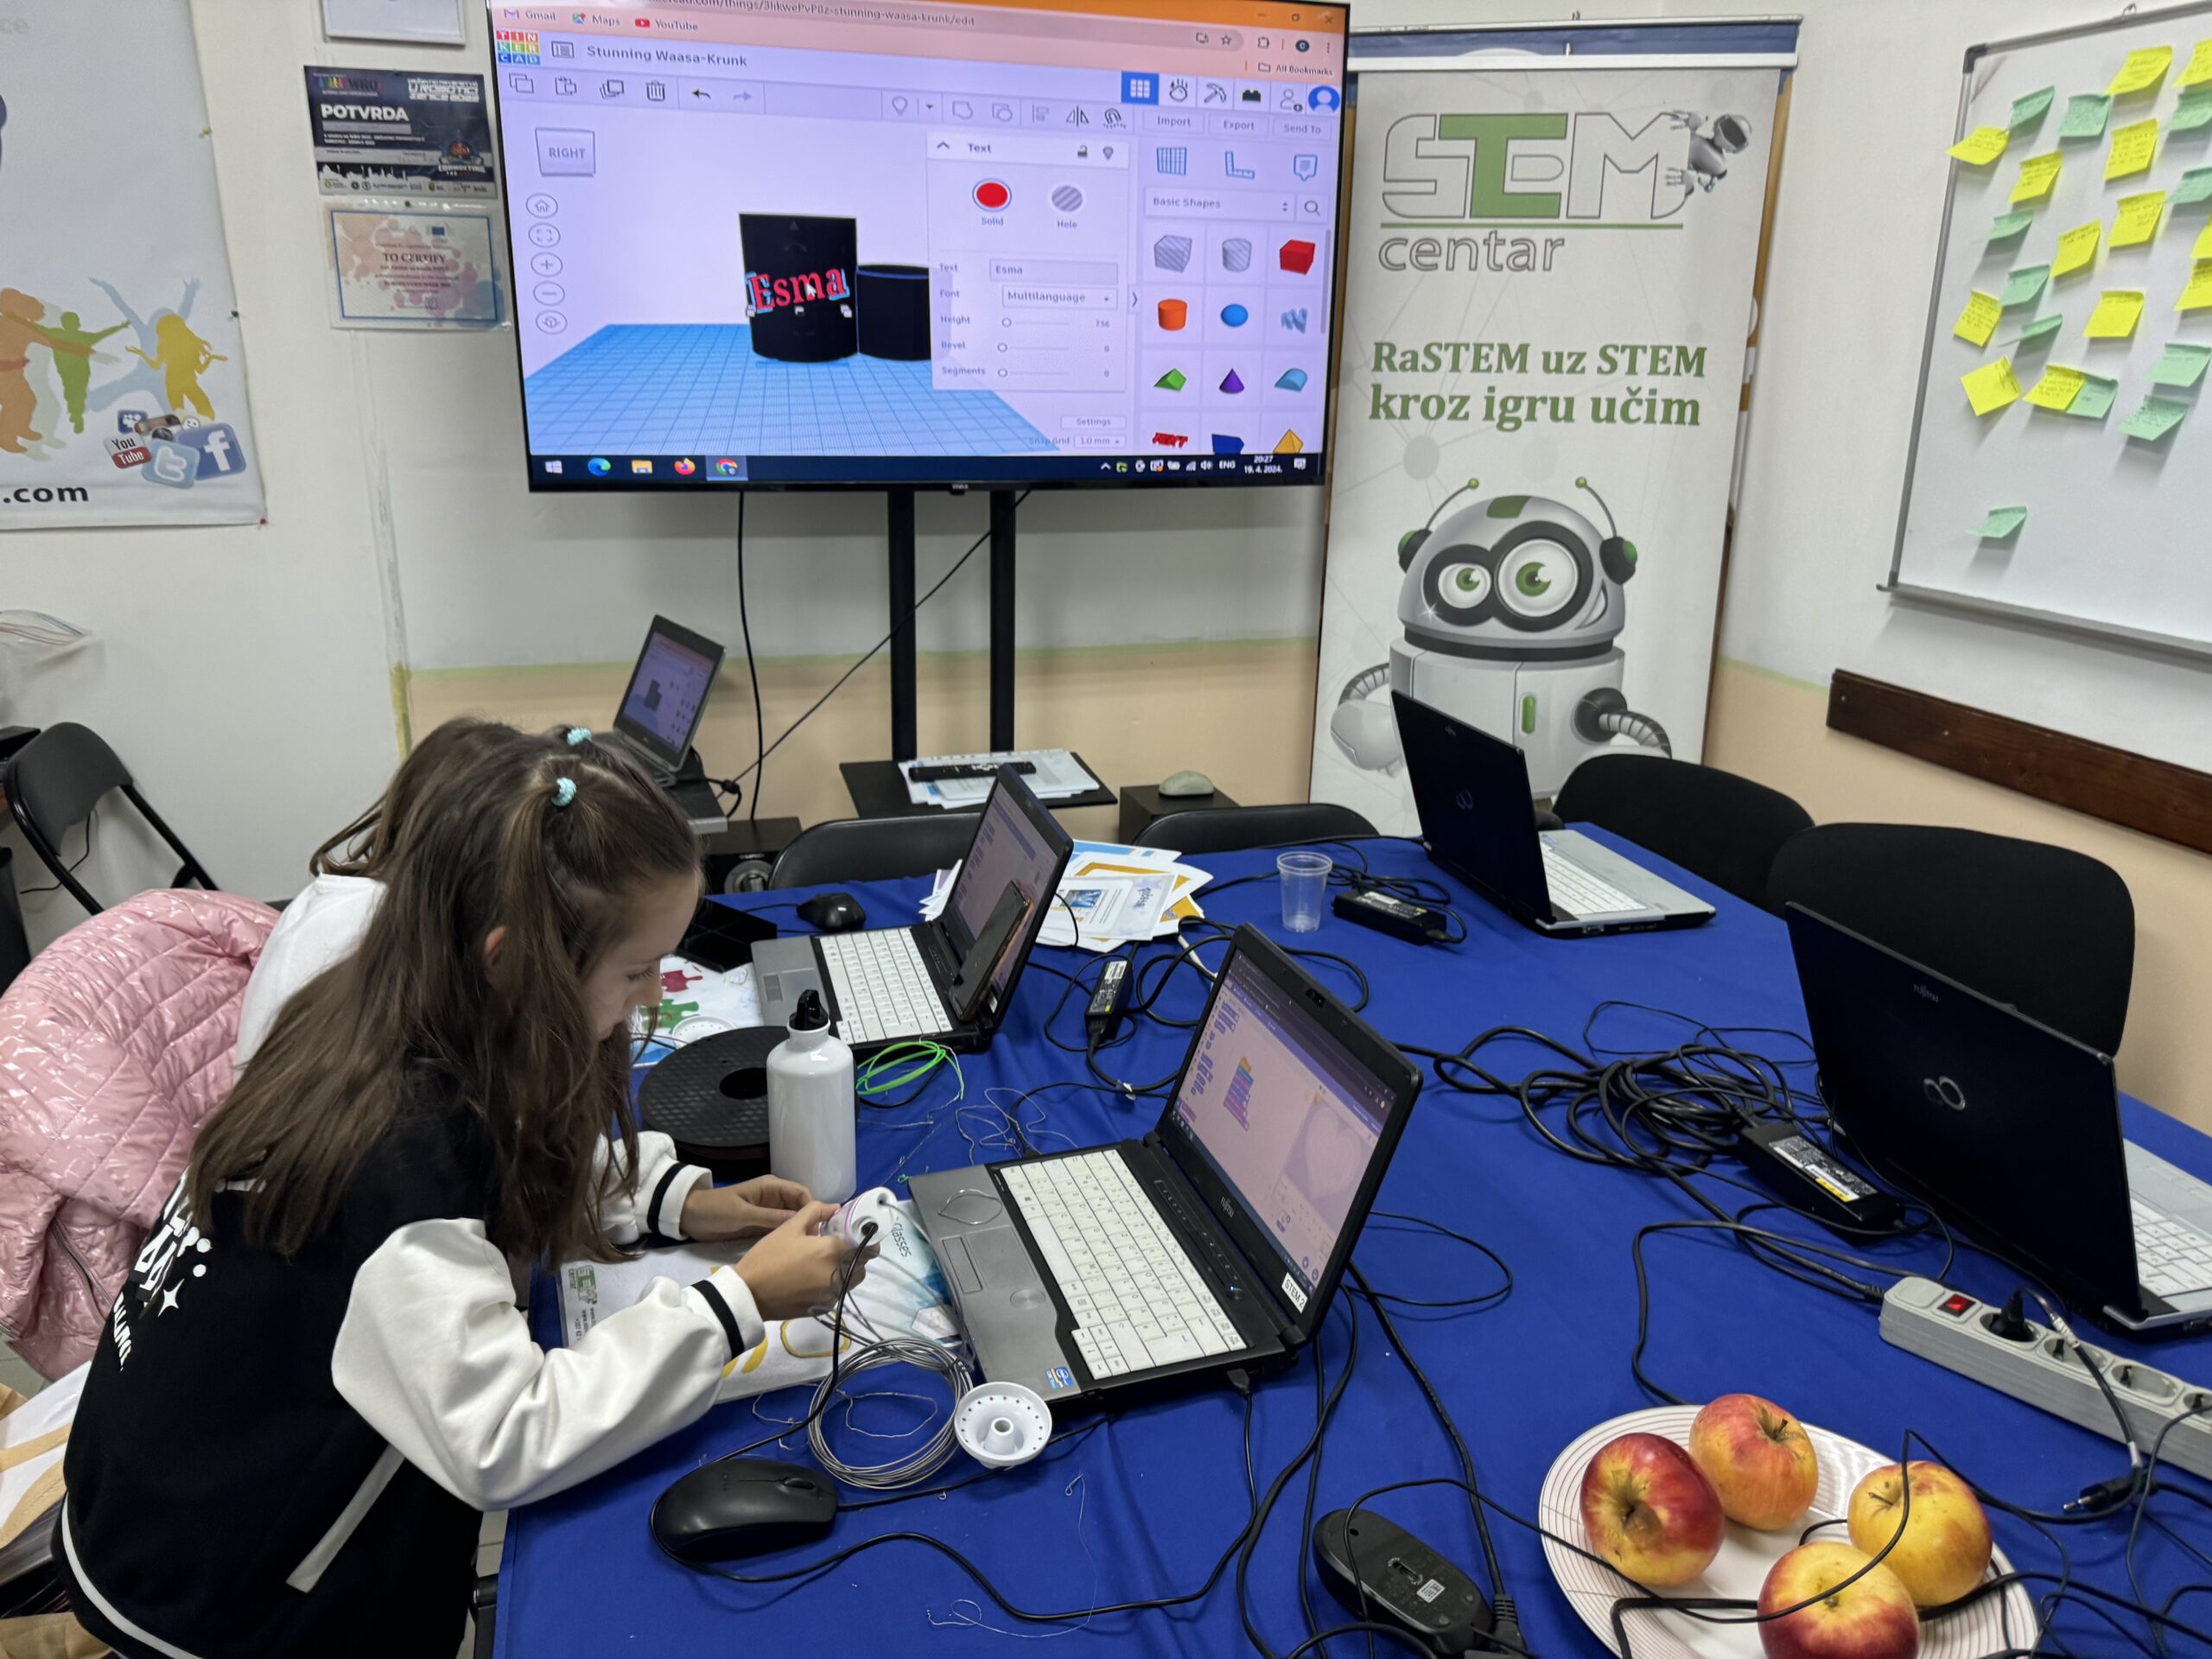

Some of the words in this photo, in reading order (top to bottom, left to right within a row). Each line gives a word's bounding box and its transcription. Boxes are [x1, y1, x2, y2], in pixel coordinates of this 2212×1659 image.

[524, 10, 556, 22] Gmail
[592, 14, 621, 29] Maps
[655, 19, 699, 33] YouTube
[587, 45, 652, 63] Stunning
[655, 48, 748, 67] Waasa-Krunk
[1288, 65, 1333, 76] Bookmarks
[320, 103, 410, 123] POTVRDA
[1156, 115, 1192, 129] Import
[1223, 119, 1255, 132] Export
[1283, 123, 1306, 135] Send
[1307, 124, 1321, 135] To
[548, 147, 586, 160] RIGHT
[968, 143, 992, 154] Text
[1382, 112, 1690, 219] STEM
[1153, 196, 1180, 208] Basic
[1183, 198, 1222, 211] Shapes
[981, 215, 1004, 226] Solid
[1057, 219, 1077, 229] Hole
[382, 252, 398, 262] TO
[1378, 230, 1565, 272] centar
[939, 263, 958, 272] Text
[995, 265, 1023, 275] Esma
[747, 269, 849, 313] Esma
[939, 289, 960, 298] Font
[1007, 291, 1086, 303] Multilanguage
[940, 315, 971, 326] Height
[1370, 341, 1531, 375] RaSTEM
[1541, 349, 1587, 375] uz
[1596, 344, 1707, 378] STEM
[941, 366, 986, 377] Segments
[1369, 384, 1471, 422] kroz
[1482, 385, 1575, 432] igru
[1591, 385, 1700, 426] učim
[111, 436, 137, 451] You
[1052, 436, 1071, 445] Grid
[118, 449, 144, 465] Tube
[1218, 460, 1236, 470] ENG
[3, 486, 89, 504] .com
[1285, 1278, 1301, 1303] STEM
